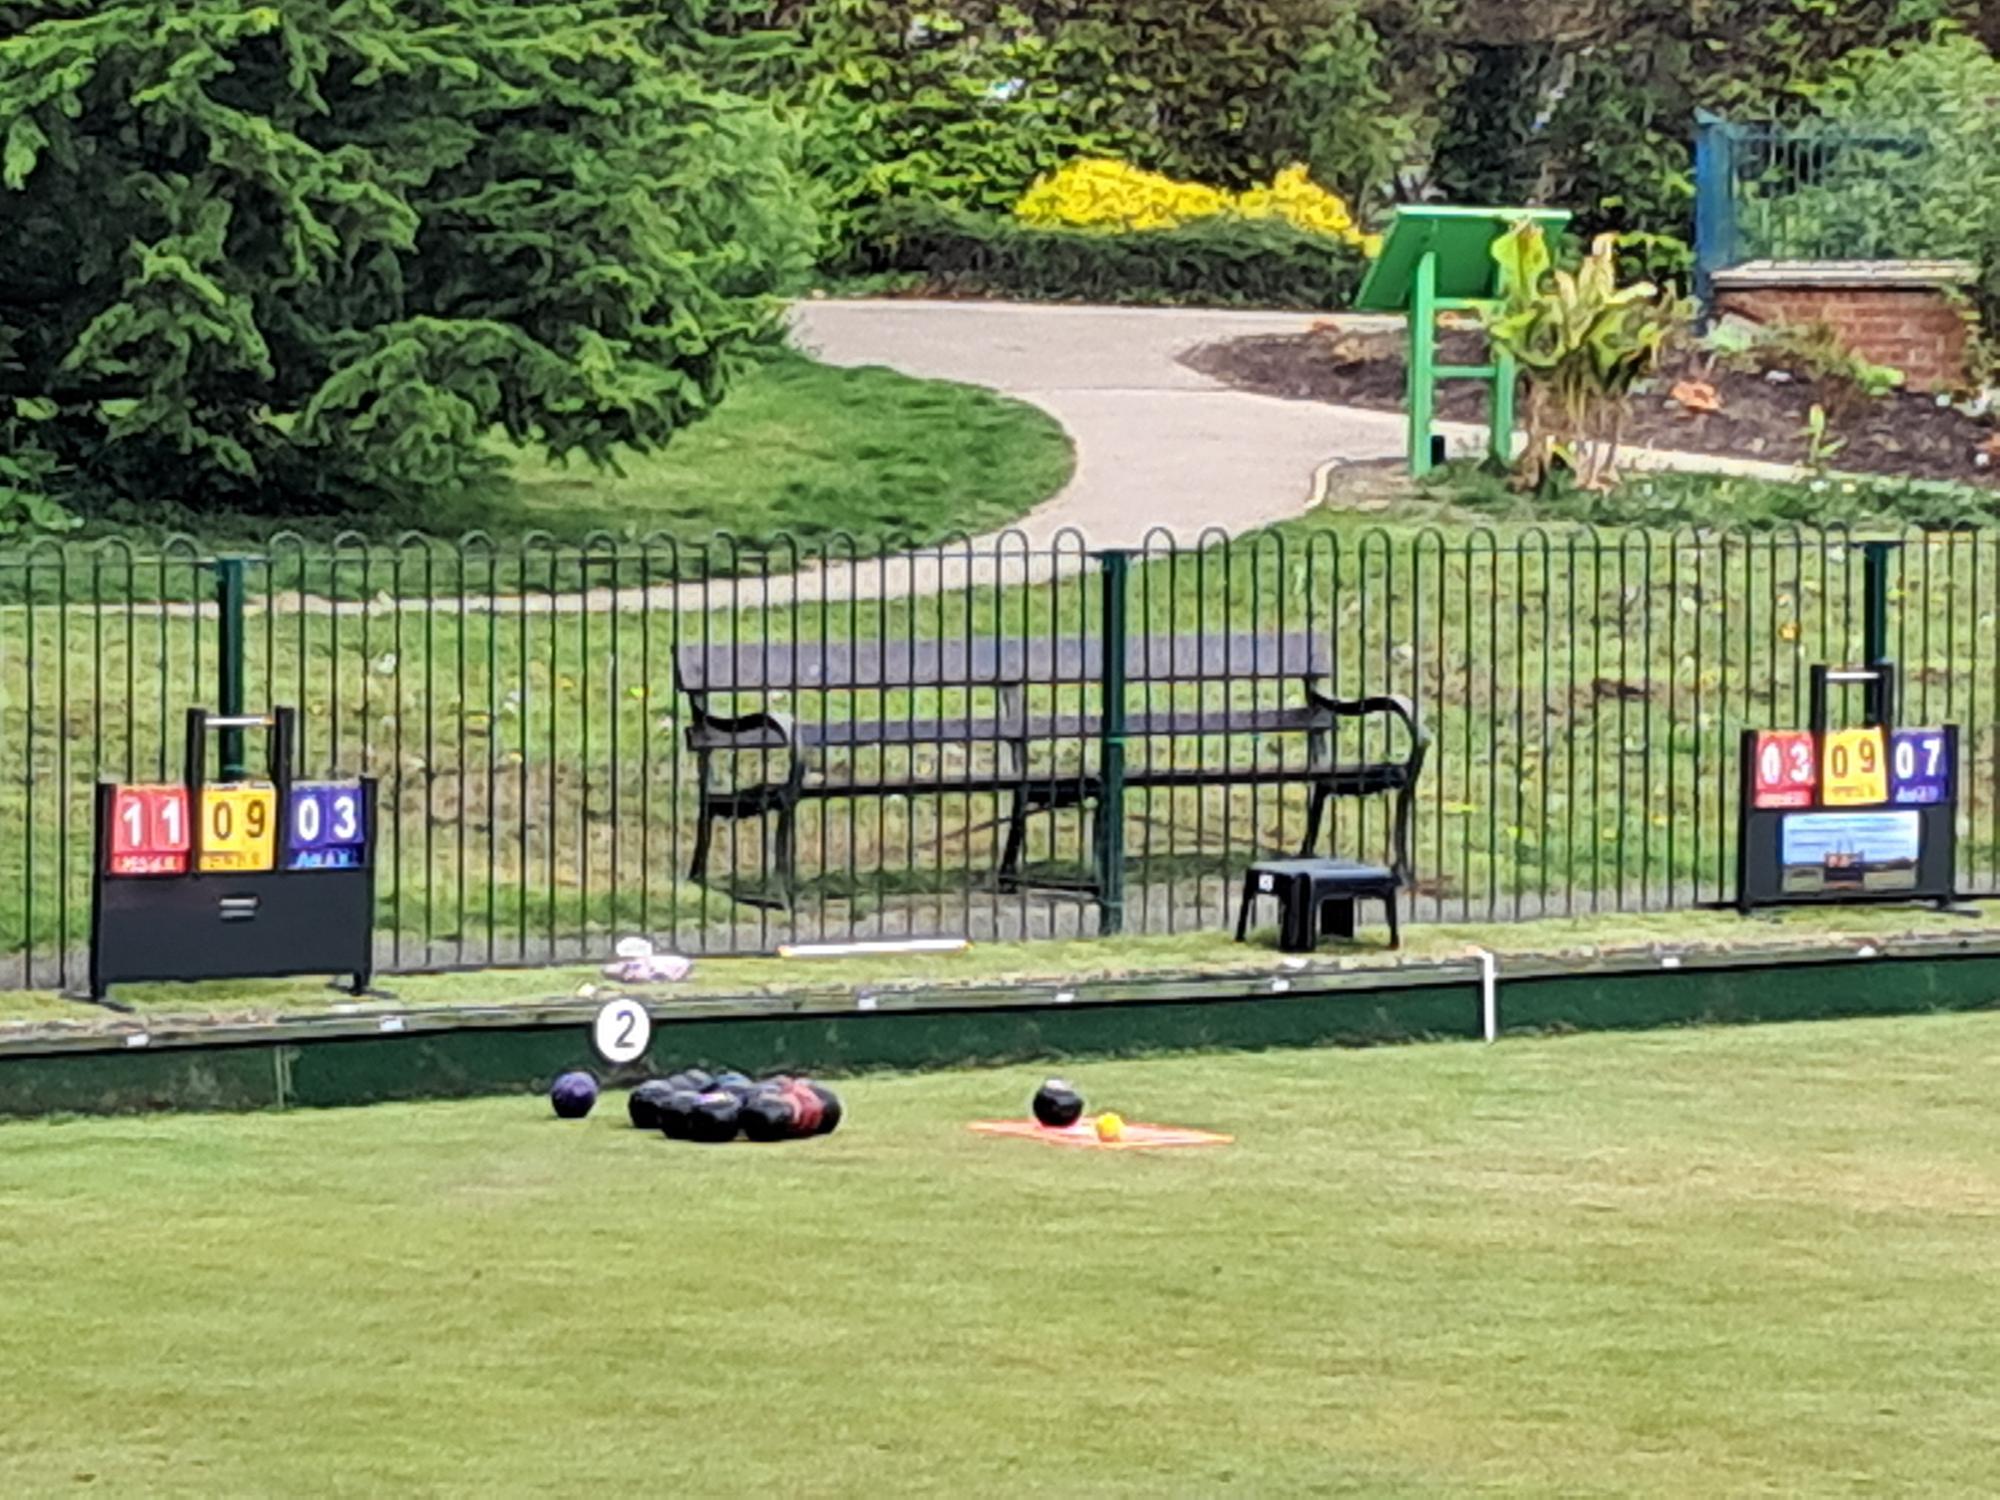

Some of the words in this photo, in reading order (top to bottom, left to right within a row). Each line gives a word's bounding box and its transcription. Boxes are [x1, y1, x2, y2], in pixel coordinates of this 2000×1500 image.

[1761, 742, 1810, 784] 03
[1831, 738, 1876, 778] 09
[1895, 738, 1941, 779] 07
[122, 797, 181, 847] 11
[213, 799, 266, 840] 09
[298, 796, 357, 841] 03
[614, 1009, 636, 1048] 2
